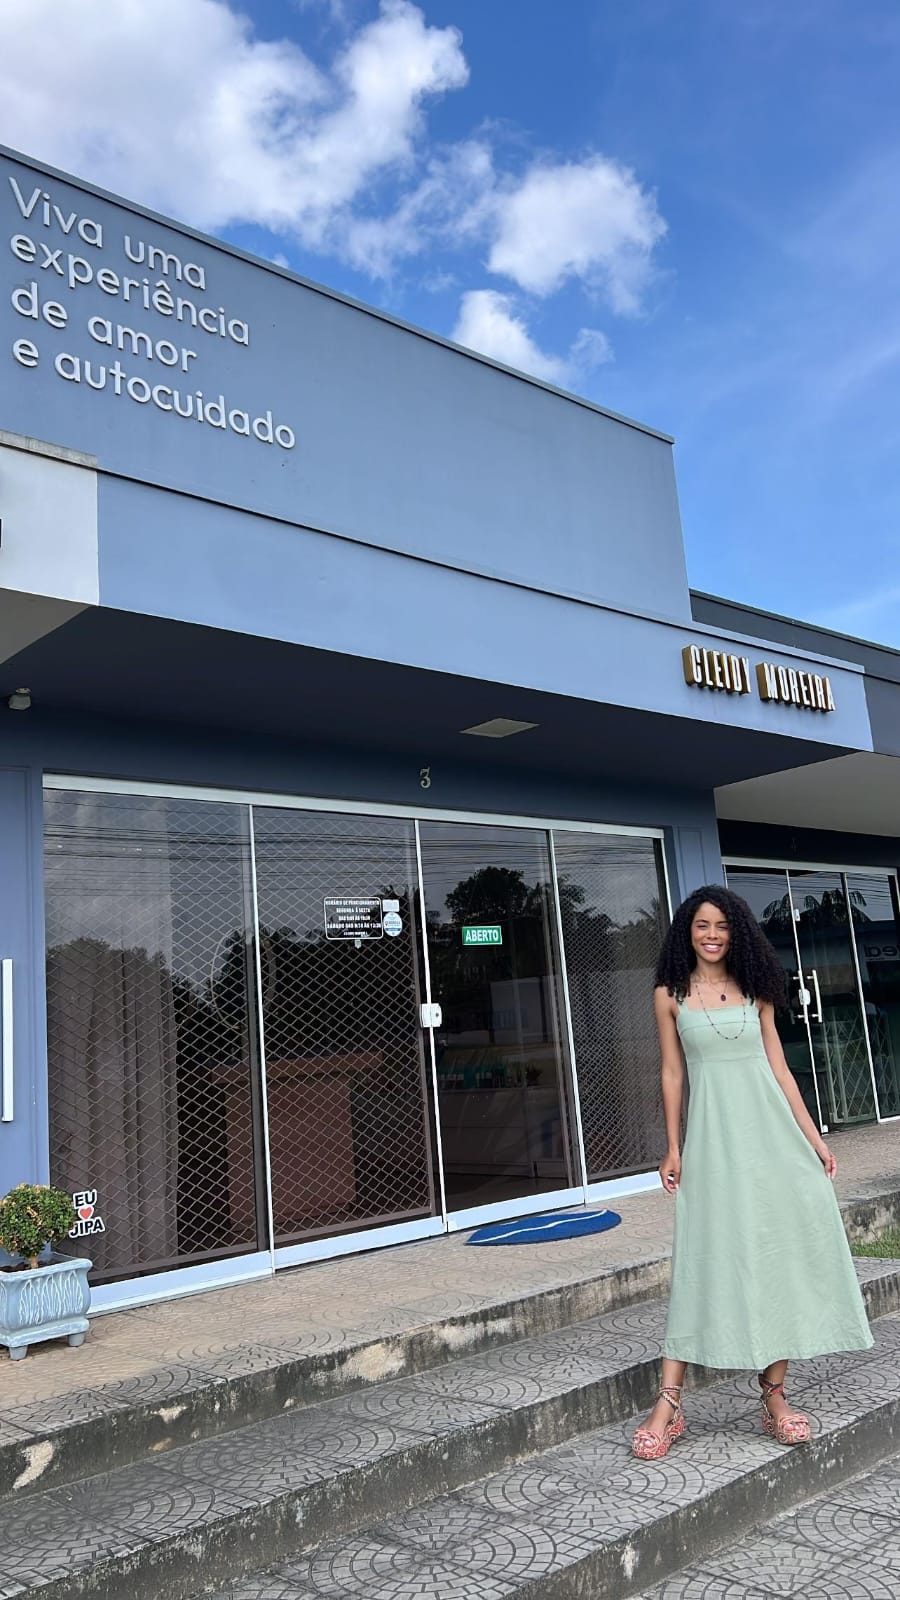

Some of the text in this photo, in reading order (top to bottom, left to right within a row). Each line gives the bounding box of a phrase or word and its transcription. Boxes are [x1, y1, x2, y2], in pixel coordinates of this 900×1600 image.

[9, 177, 206, 290] Viva uma
[10, 234, 249, 346] experiência
[11, 282, 197, 371] de amor
[13, 338, 296, 449] e autocuidado
[684, 644, 836, 712] CLEIDY MOREIRA
[419, 767, 431, 788] 3
[465, 928, 499, 942] ABERTO
[70, 1219, 104, 1237] JIPA
[74, 1191, 96, 1207] EU
